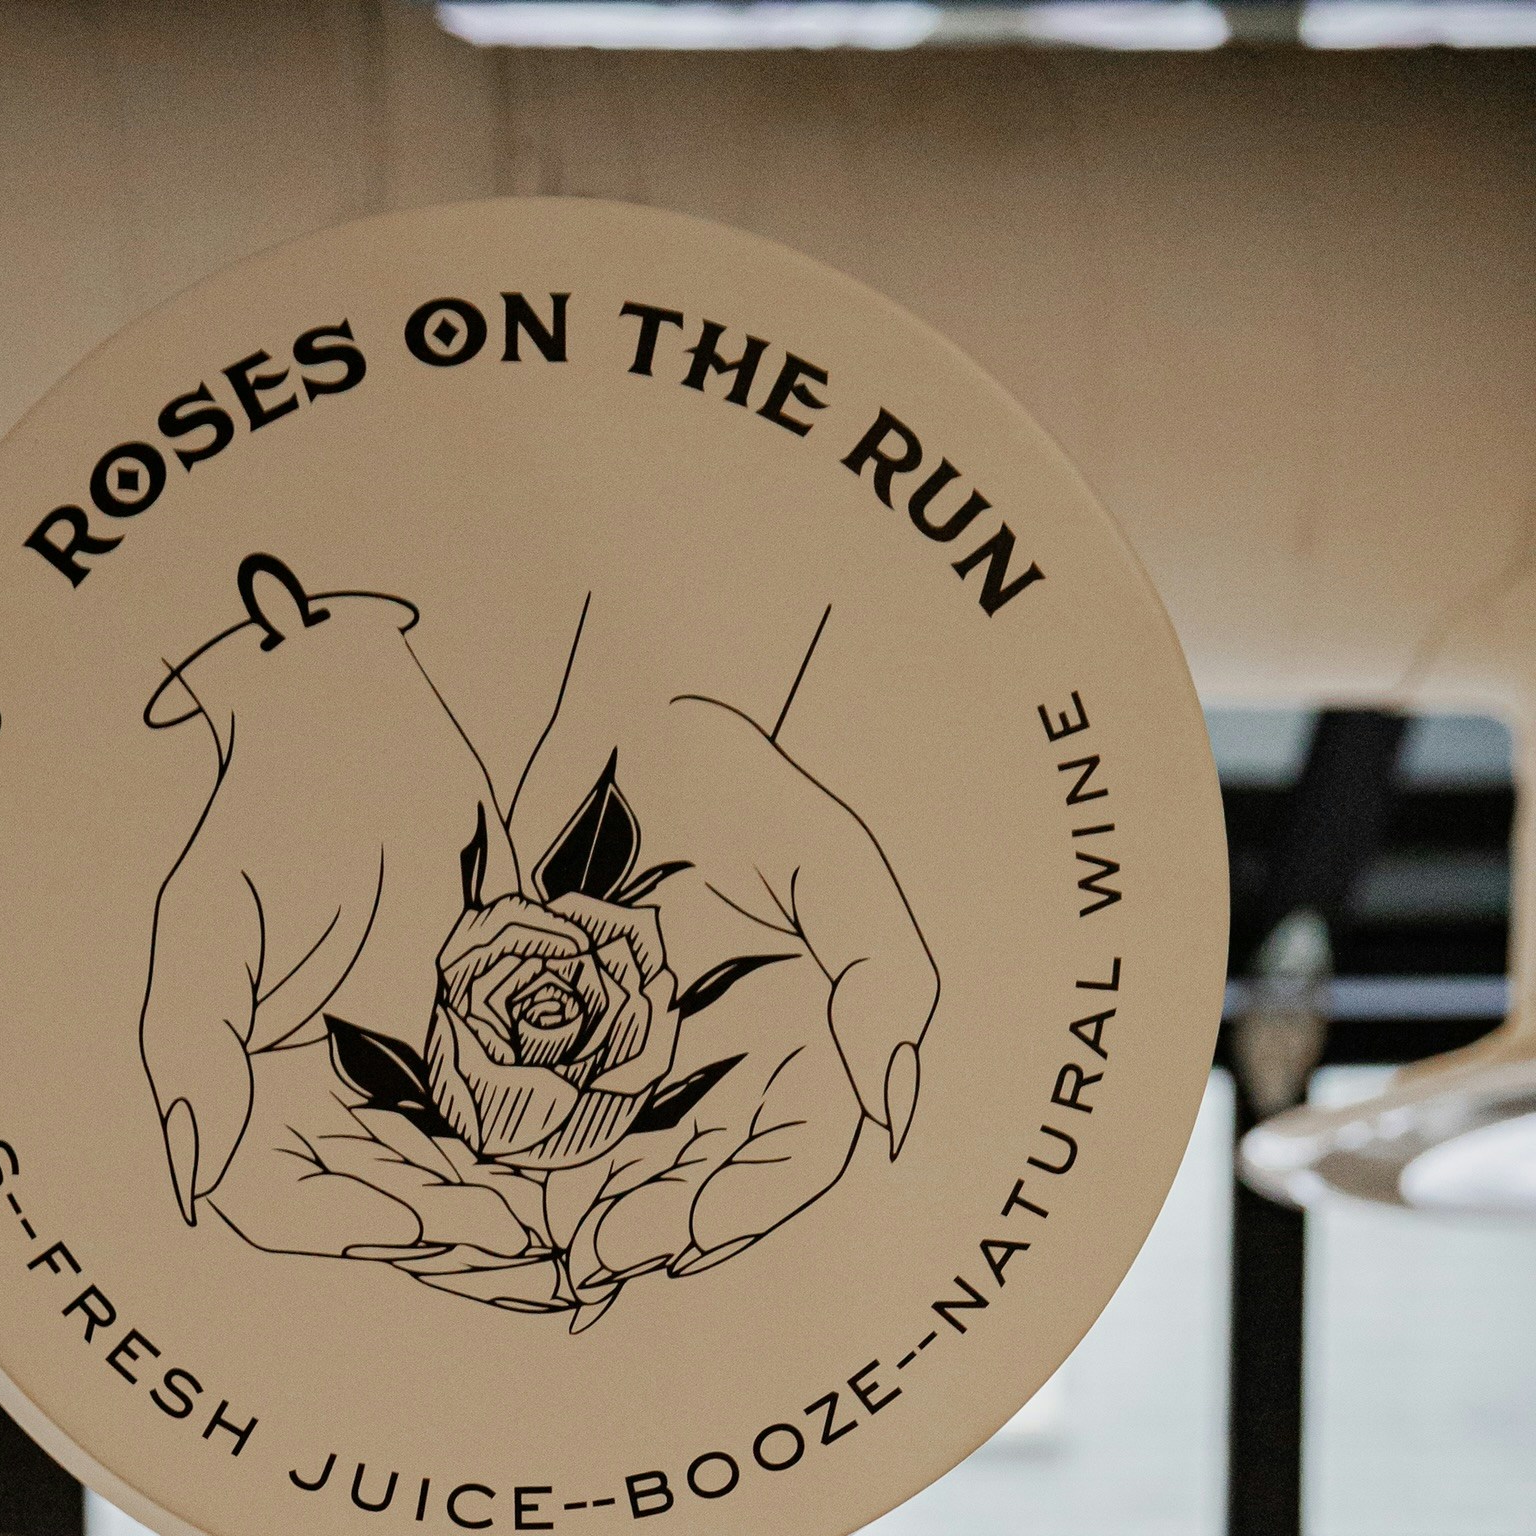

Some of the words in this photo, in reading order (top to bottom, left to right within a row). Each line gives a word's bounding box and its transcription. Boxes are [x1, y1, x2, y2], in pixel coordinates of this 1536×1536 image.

[22, 317, 368, 590] ROSES
[403, 291, 572, 369] ON
[618, 300, 829, 439] THE
[839, 406, 1047, 619] RUN
[1037, 689, 1123, 919] WINE
